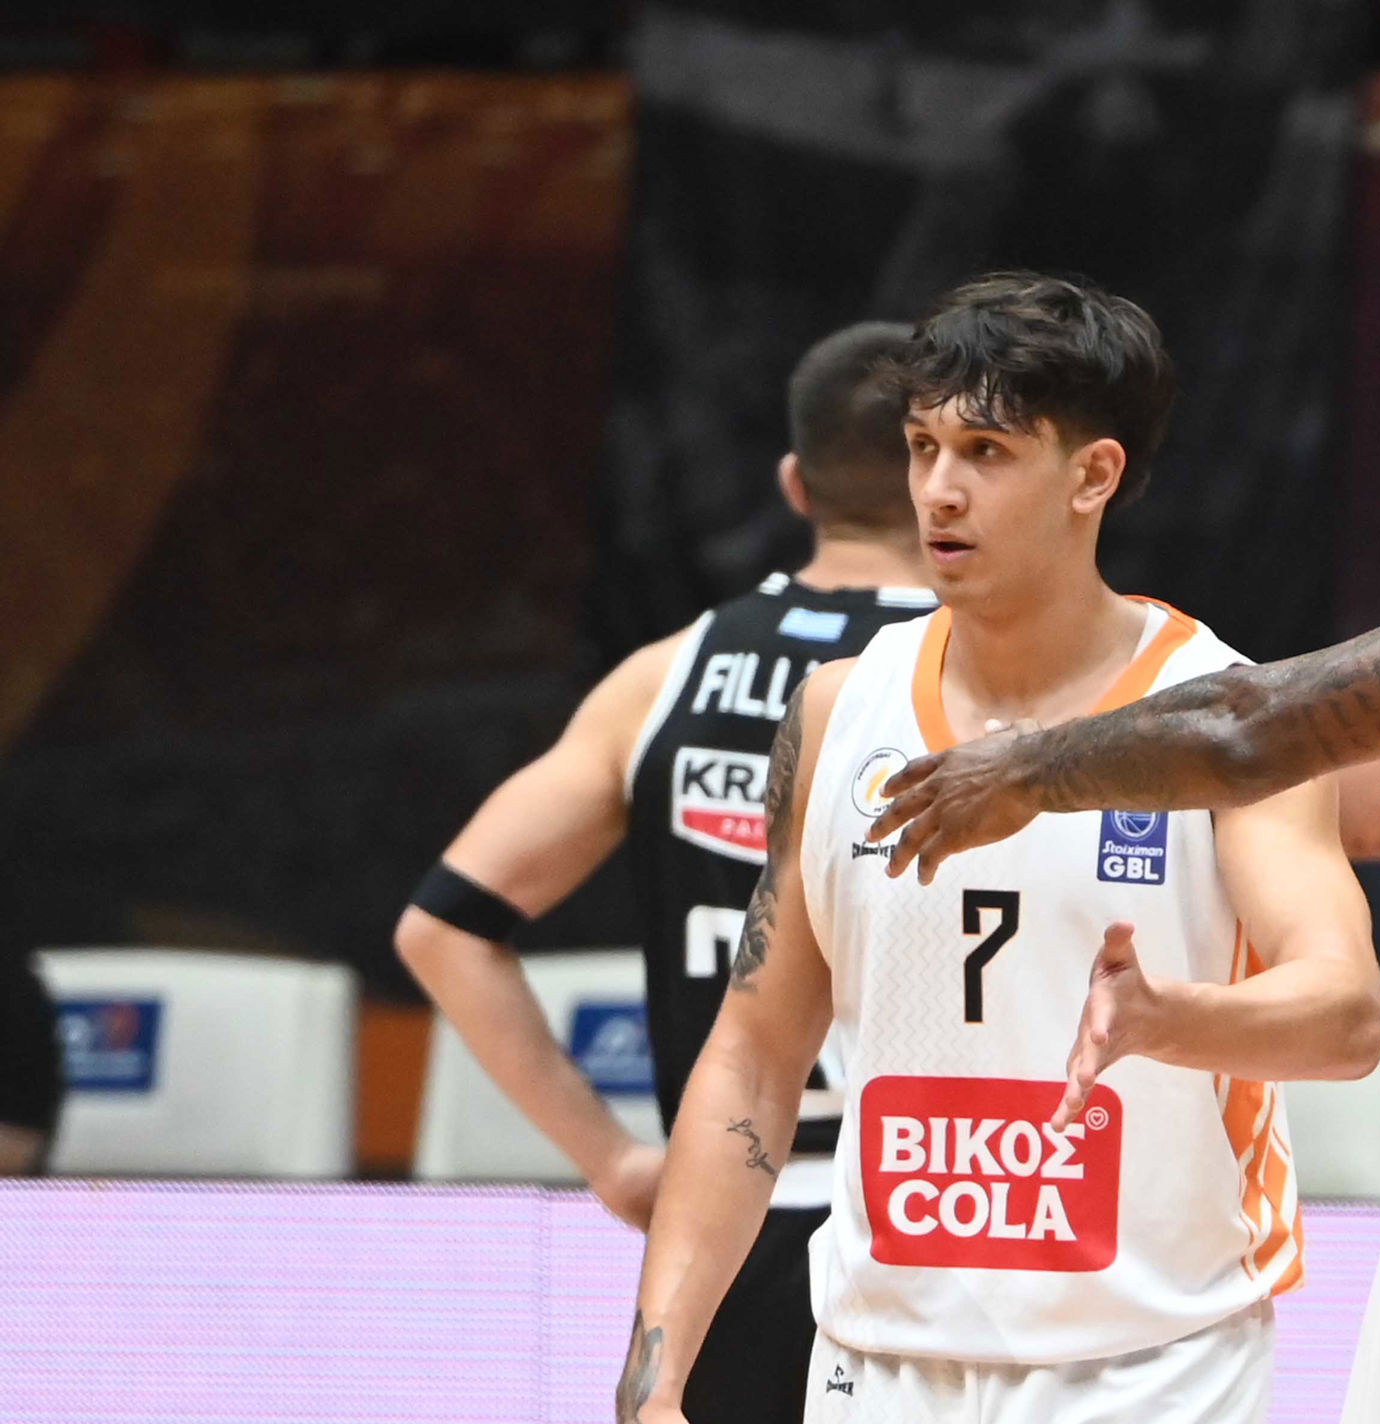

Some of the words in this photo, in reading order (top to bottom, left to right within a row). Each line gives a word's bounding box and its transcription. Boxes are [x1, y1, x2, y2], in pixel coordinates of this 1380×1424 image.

[691, 652, 820, 721] FILL
[683, 759, 767, 802] KR
[1102, 840, 1164, 857] Stoiximan
[1103, 855, 1159, 880] GBL
[961, 889, 1021, 1024] 7
[879, 1115, 1086, 1181] ΒΙΚΟΣ
[888, 1180, 1077, 1242] COLA
